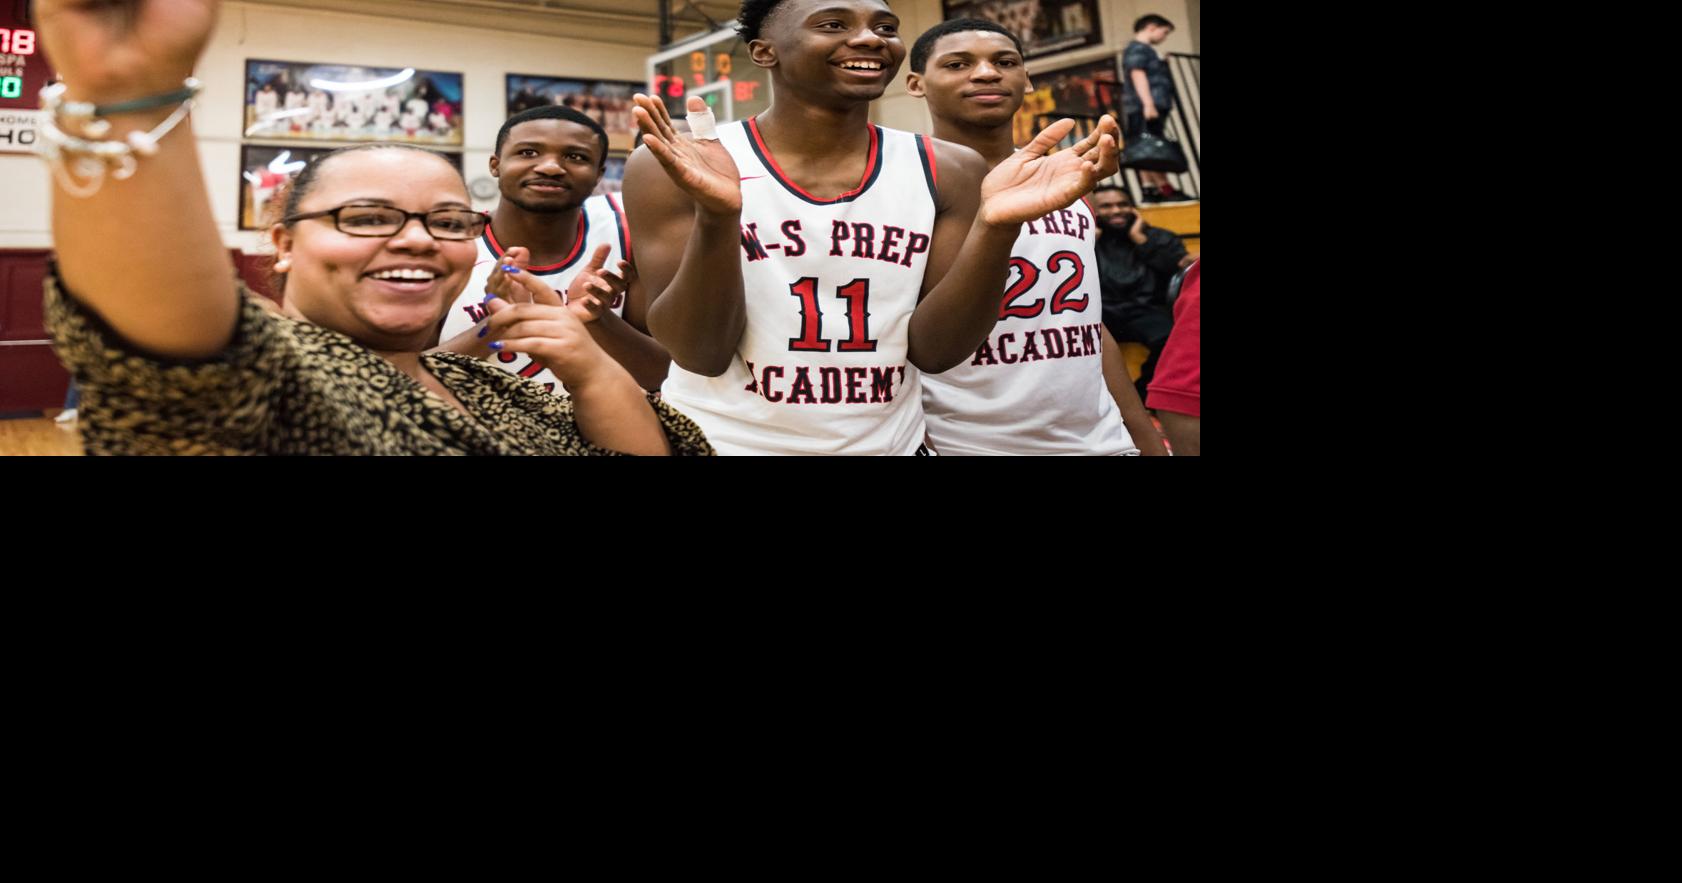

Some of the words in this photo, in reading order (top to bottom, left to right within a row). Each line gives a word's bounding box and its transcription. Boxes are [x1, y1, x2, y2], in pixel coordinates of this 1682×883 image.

[741, 219, 806, 262] W-S
[829, 219, 930, 268] PREP
[788, 276, 878, 352] 11
[998, 250, 1089, 321] 22
